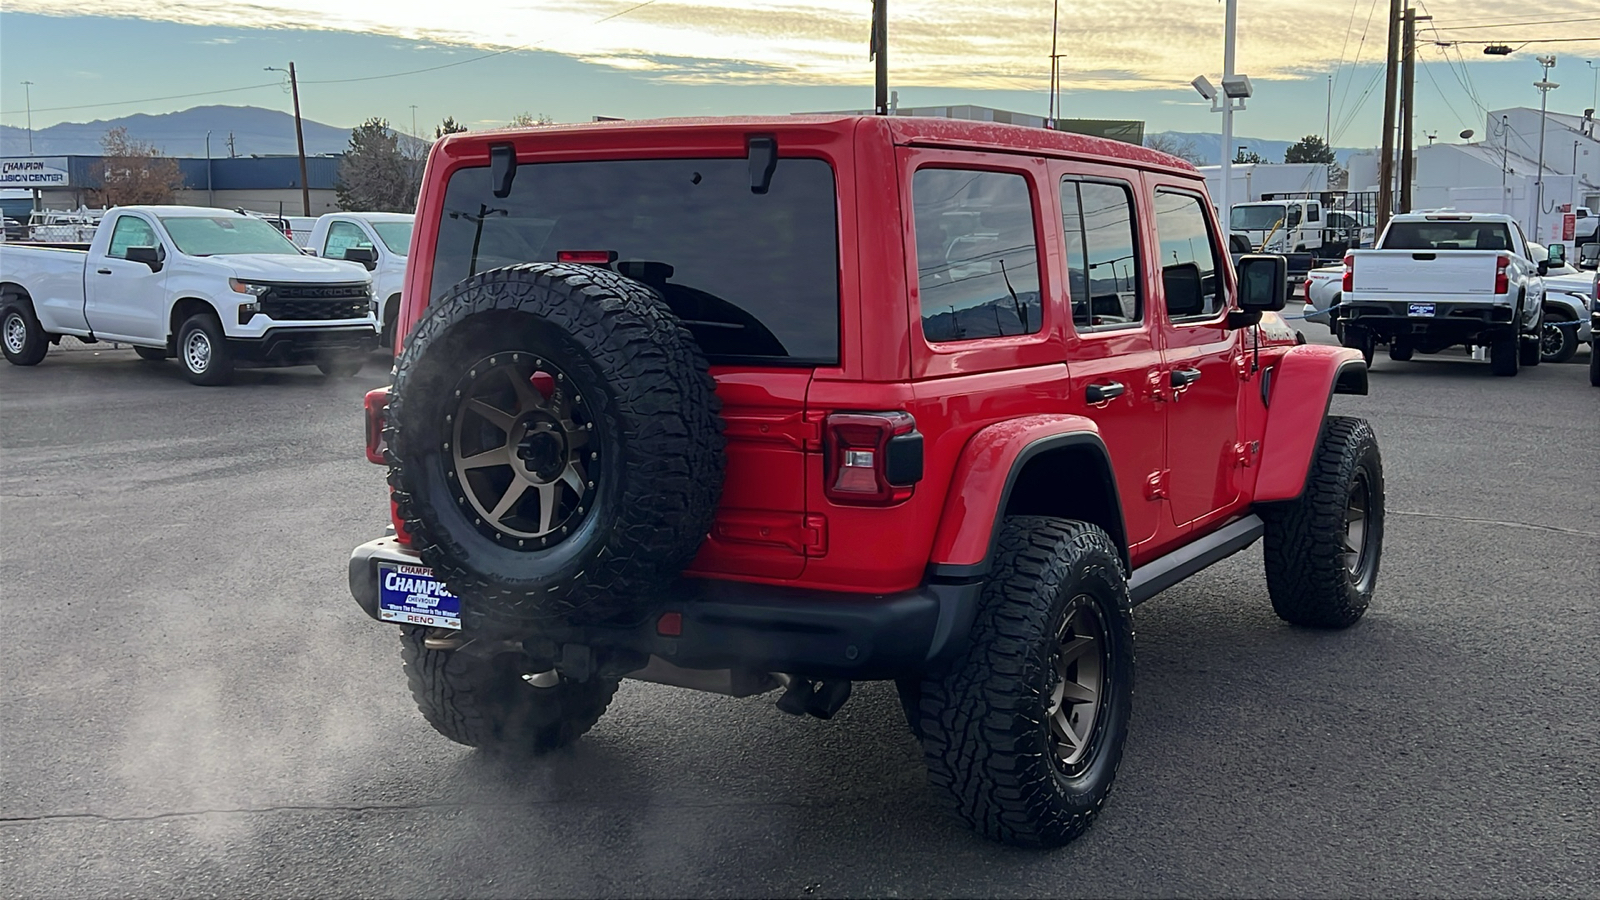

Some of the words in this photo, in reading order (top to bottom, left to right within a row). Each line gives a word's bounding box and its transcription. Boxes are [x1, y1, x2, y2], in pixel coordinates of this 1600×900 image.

[2, 162, 45, 173] CHAMPION
[0, 174, 28, 182] LISION
[28, 173, 63, 181] CENTER
[280, 287, 366, 297] CHEVROLET
[407, 596, 437, 605] CHEVROLET
[407, 615, 435, 625] RENO
